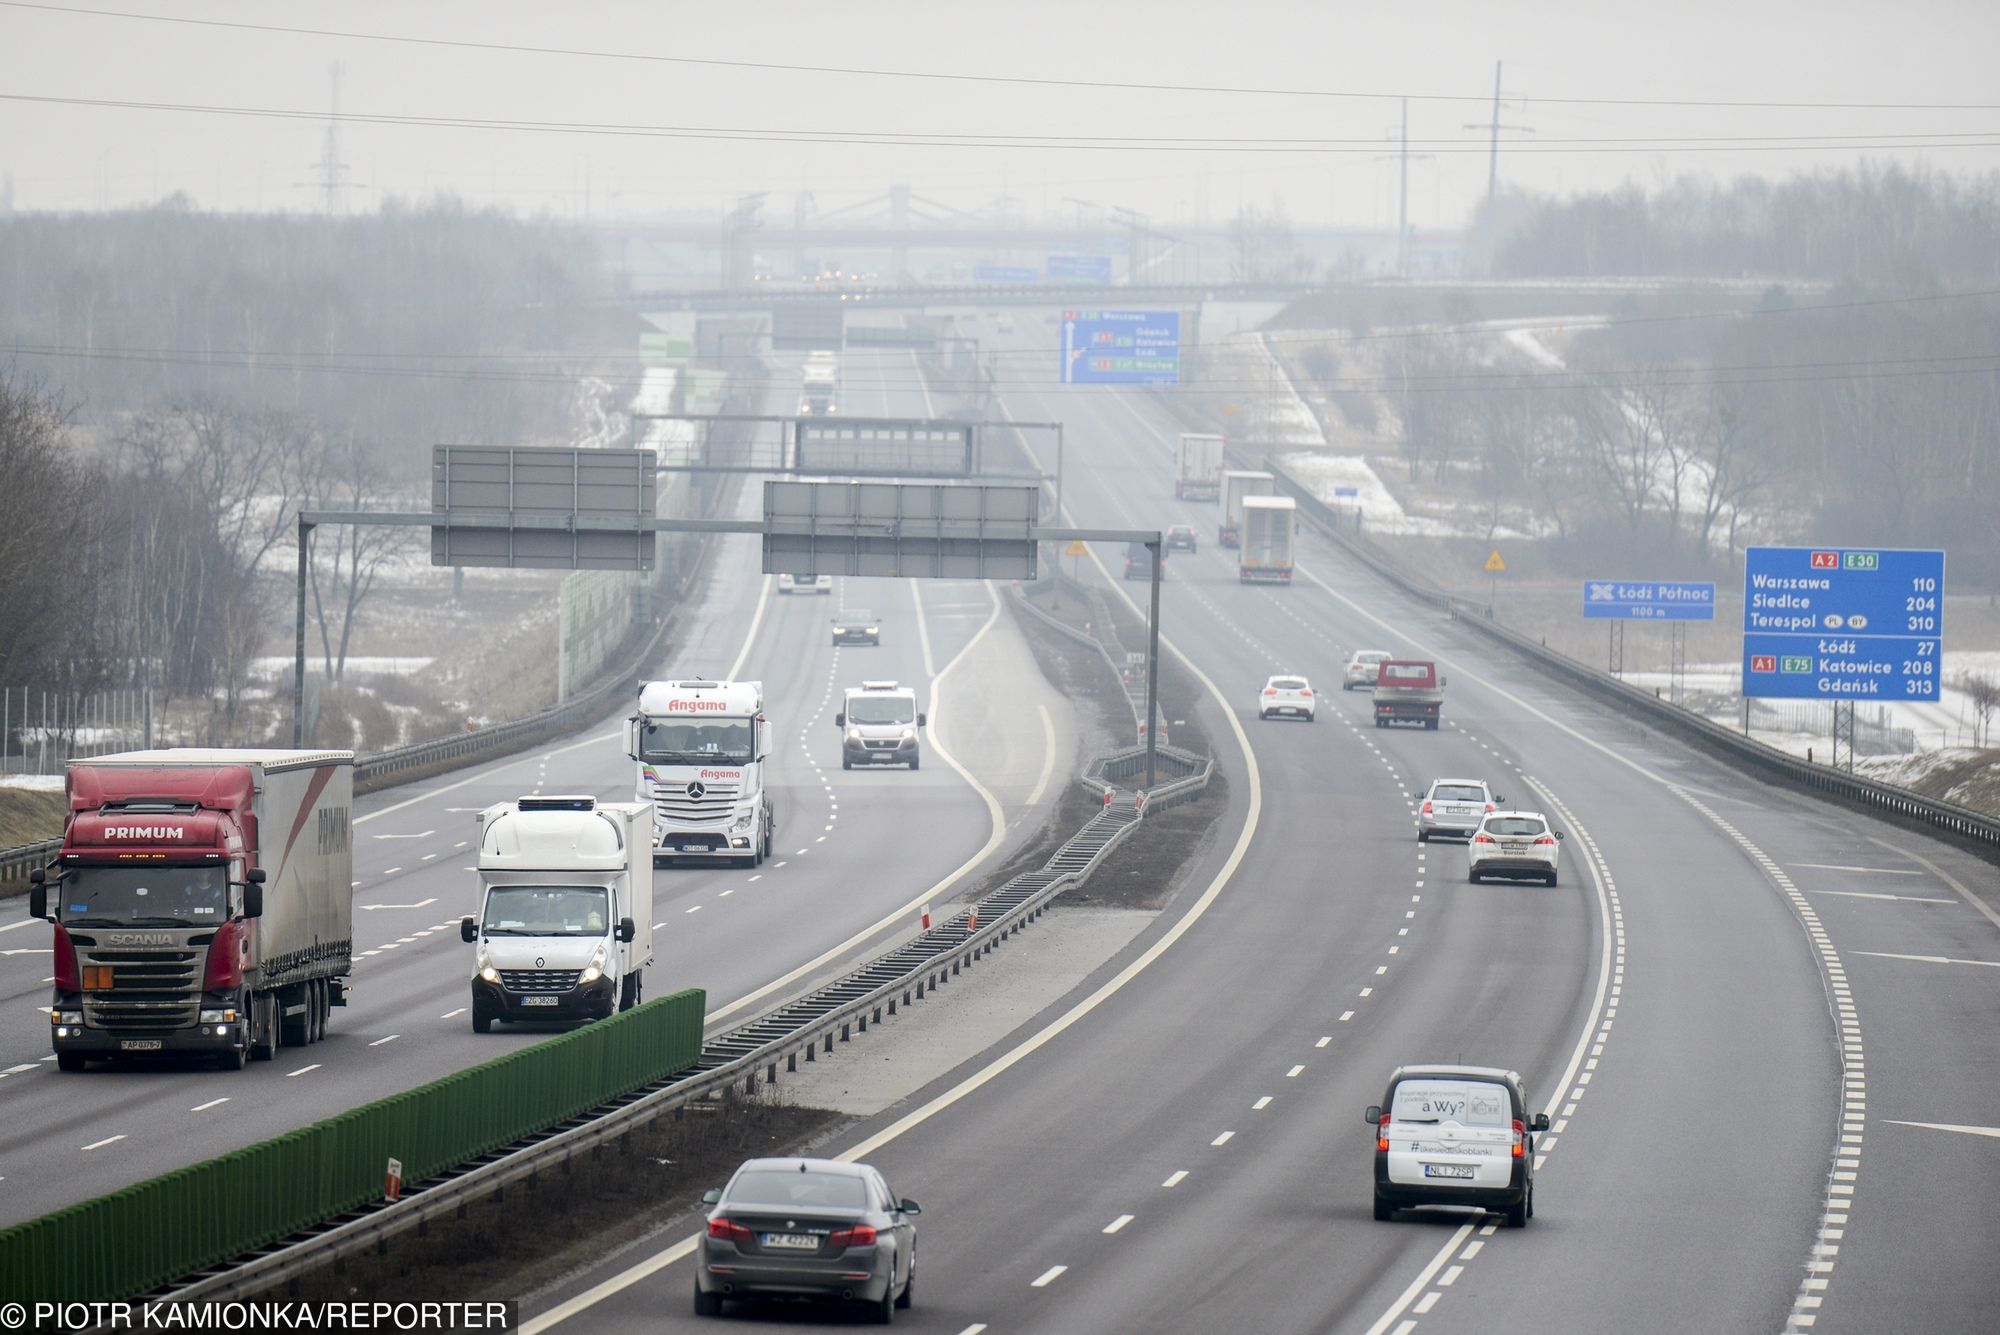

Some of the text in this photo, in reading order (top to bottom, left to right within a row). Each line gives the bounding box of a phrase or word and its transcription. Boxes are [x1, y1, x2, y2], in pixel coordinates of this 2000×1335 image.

[1752, 574, 1936, 591] Warszawa 110
[1617, 585, 1709, 600] Łódź Północ
[1752, 594, 1936, 611] Siedlce 204
[1631, 607, 1665, 617] 1100 m
[1751, 613, 1934, 631] Terespol PL BY 310
[1818, 639, 1935, 656] Łódź 27
[1819, 659, 1892, 674] Katowice
[1902, 660, 1933, 675] 208
[1818, 677, 1933, 694] Gdańsk 313
[669, 699, 727, 713] Angama
[700, 769, 740, 780] Angama
[104, 827, 184, 839] PRIMUM
[318, 807, 348, 857] PRIMUM
[110, 934, 173, 946] SCANIA
[1422, 1100, 1465, 1116] a Wy?
